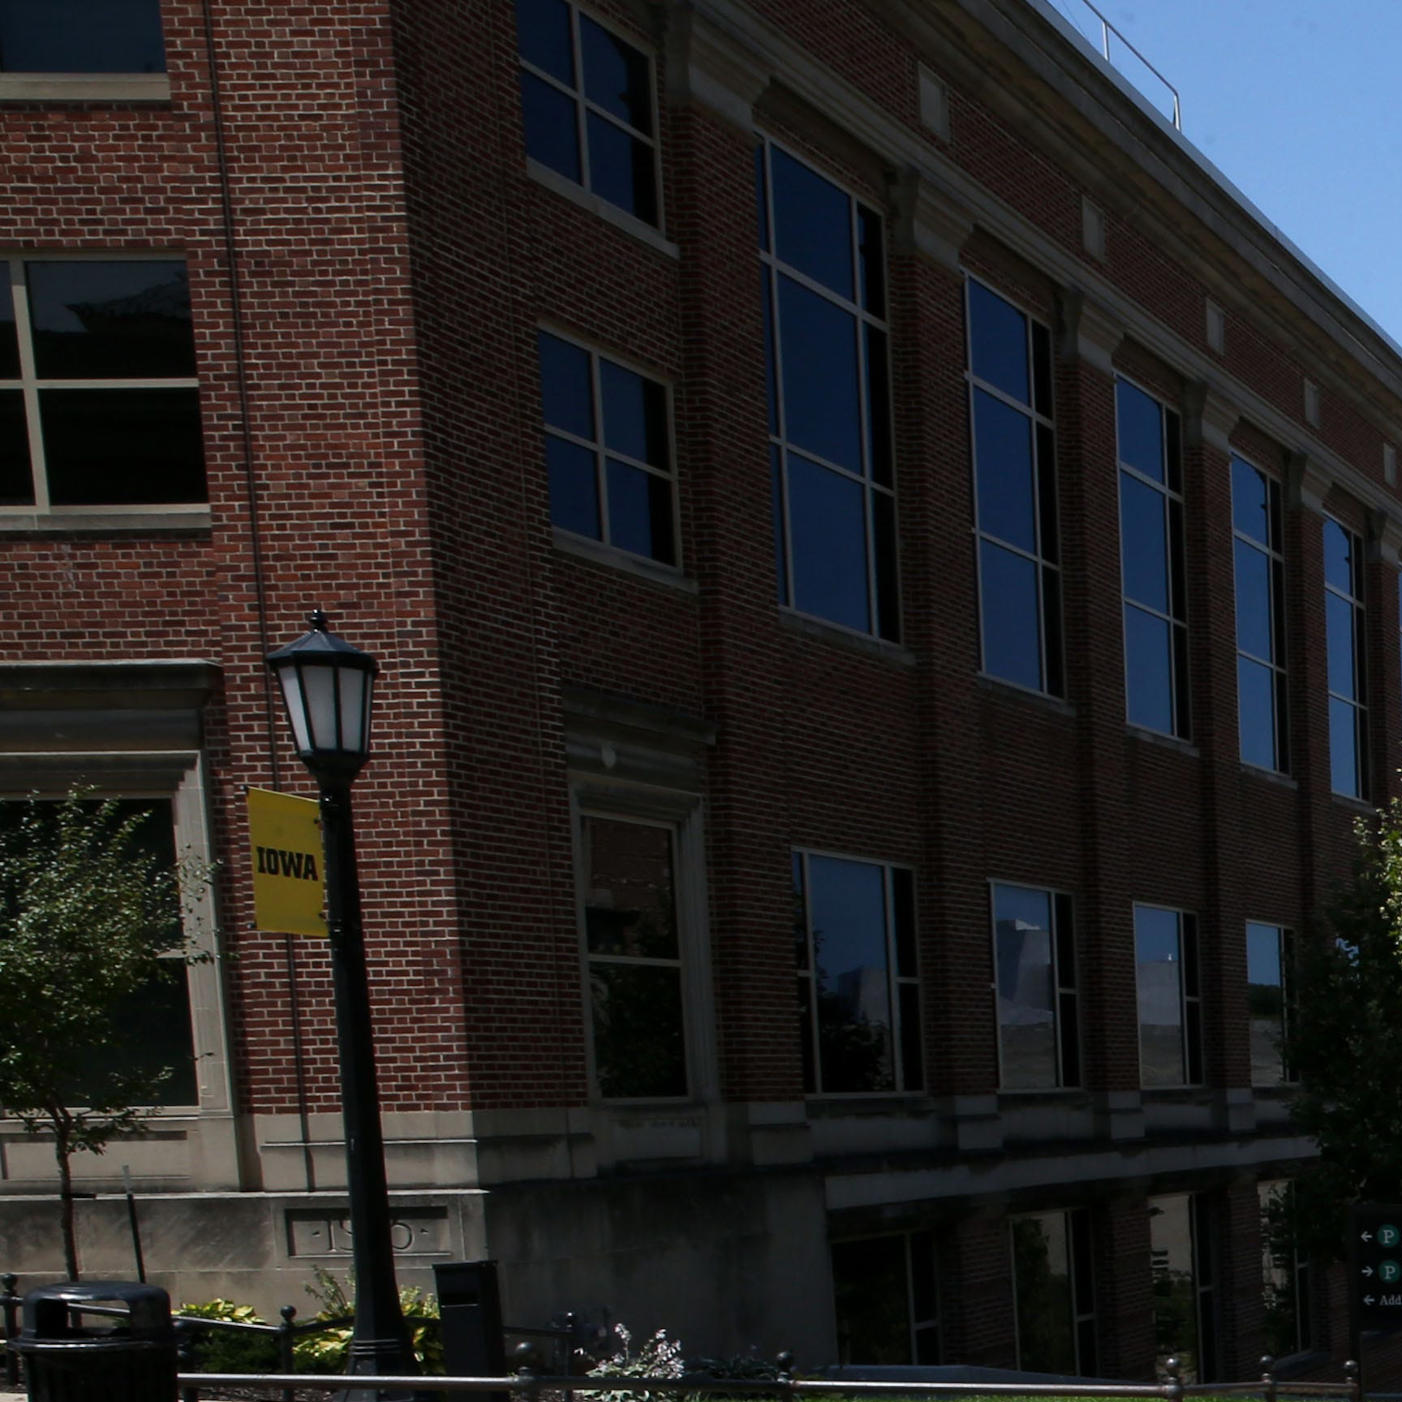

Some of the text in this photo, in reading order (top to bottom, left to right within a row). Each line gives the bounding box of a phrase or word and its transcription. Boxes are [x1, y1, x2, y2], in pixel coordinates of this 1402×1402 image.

[256, 845, 318, 881] IOWA
[1383, 1229, 1395, 1244] P
[1384, 1265, 1396, 1280] P
